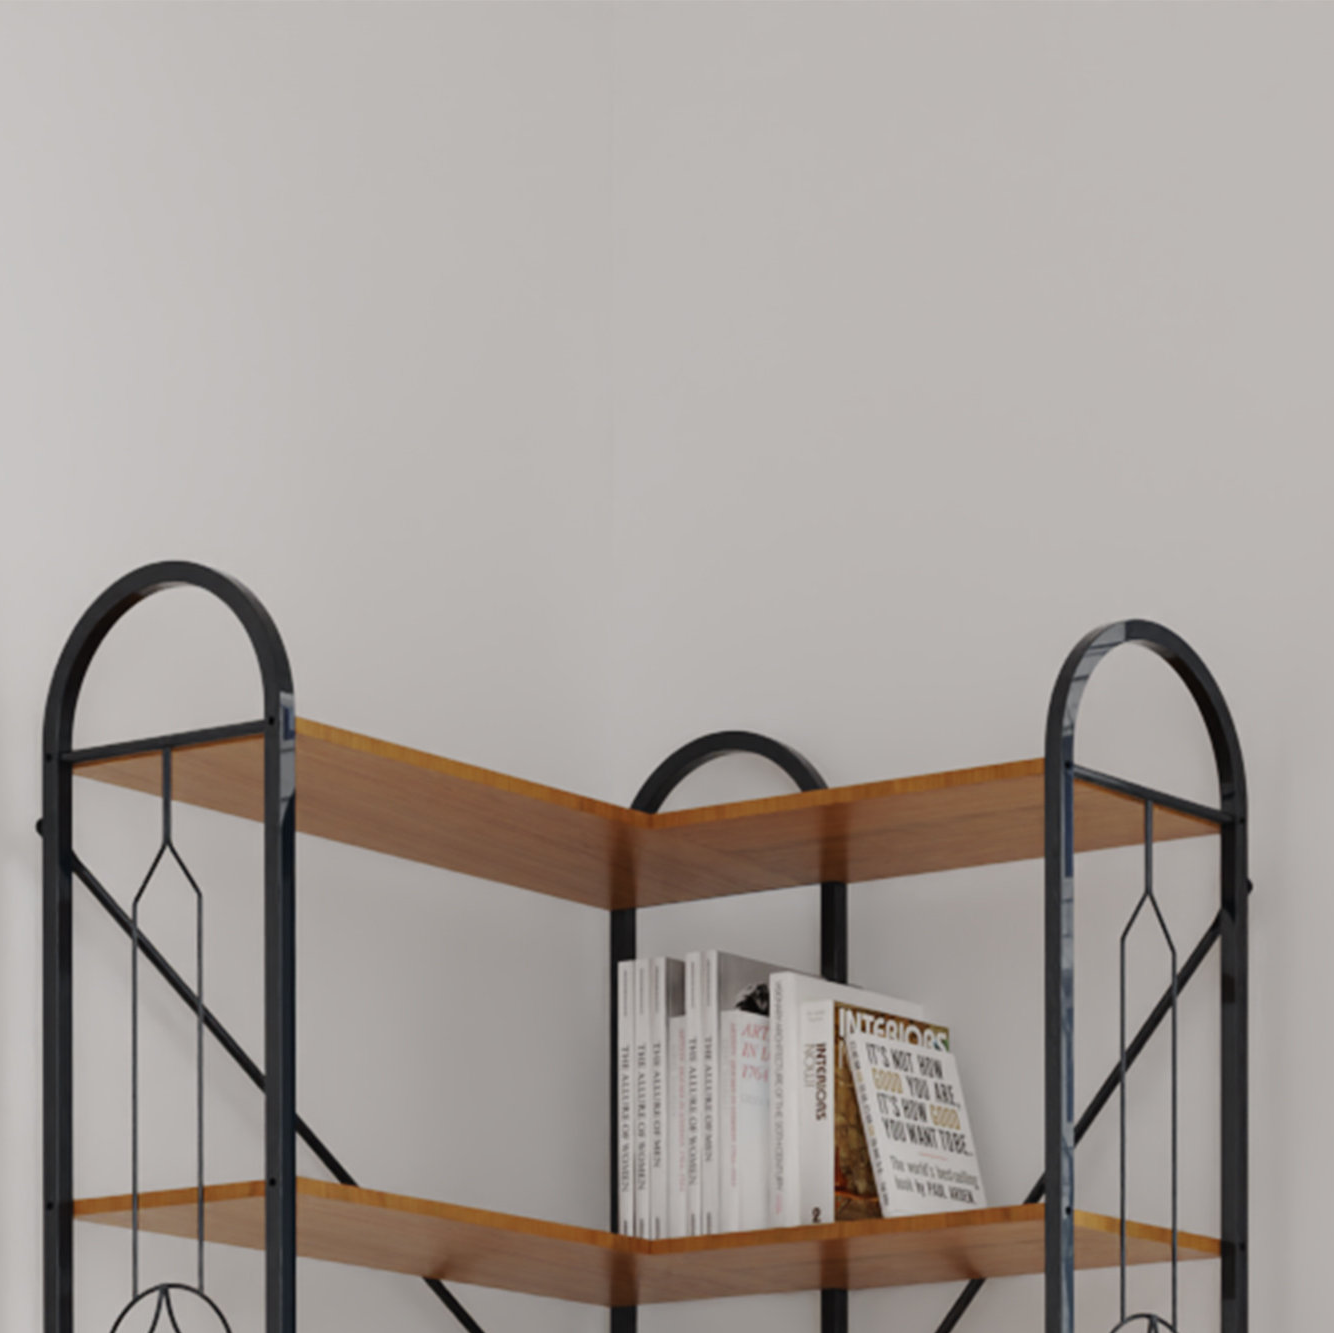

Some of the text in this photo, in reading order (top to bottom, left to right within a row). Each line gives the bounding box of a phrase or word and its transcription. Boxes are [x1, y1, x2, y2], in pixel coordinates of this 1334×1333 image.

[838, 1006, 949, 1051] INTERIORS
[866, 1042, 890, 1068] IT'S
[890, 1048, 914, 1073] NOT
[917, 1054, 943, 1079] HOW
[816, 1043, 827, 1121] INTERIORS
[871, 1067, 903, 1094] GOOD
[905, 1075, 930, 1101] YOU
[876, 1092, 961, 1130] IT'S HOW GOOD
[882, 1117, 906, 1142] YOU
[906, 1122, 938, 1149] WANT
